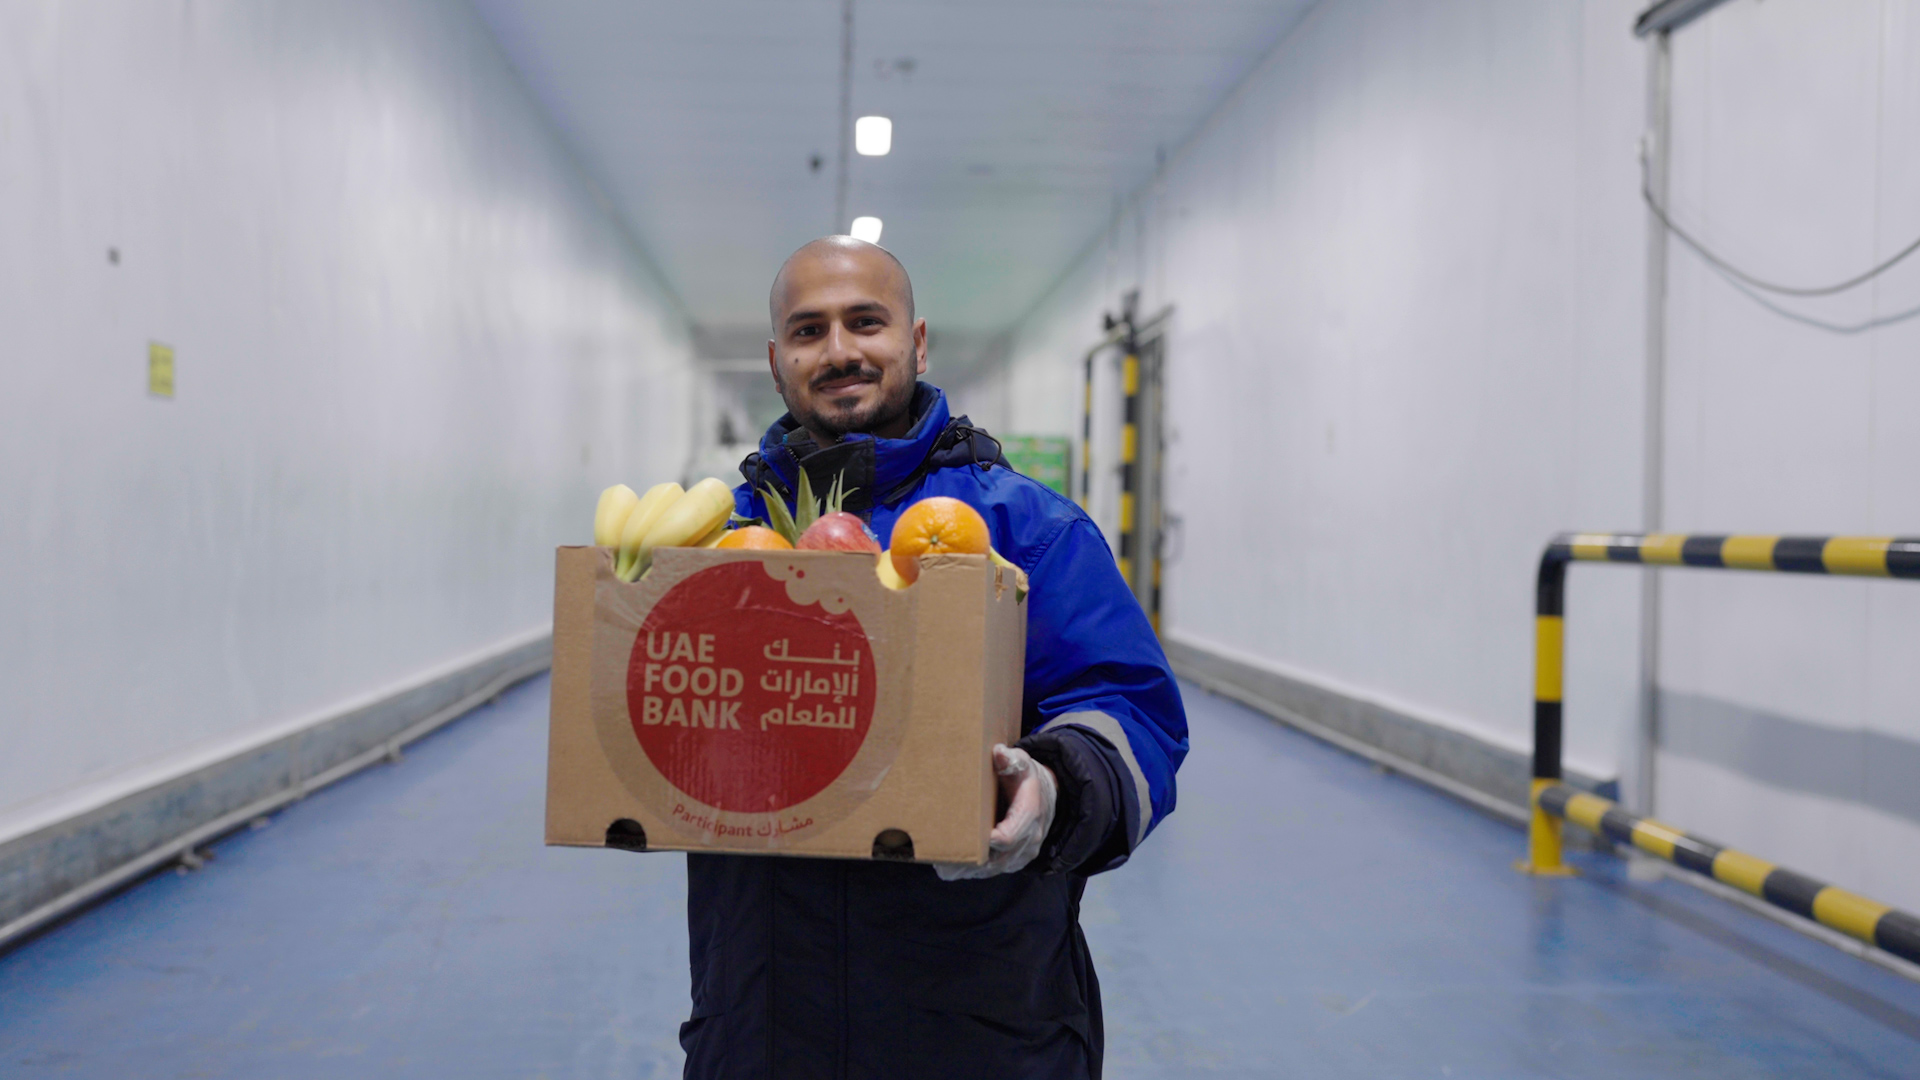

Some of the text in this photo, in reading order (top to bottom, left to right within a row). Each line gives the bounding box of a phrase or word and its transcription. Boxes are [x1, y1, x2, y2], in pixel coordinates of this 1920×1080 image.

[646, 631, 715, 663] UAE
[763, 638, 861, 672] بنك
[644, 663, 744, 697] FOOD
[760, 669, 859, 703] الإمارات
[642, 696, 743, 730] BANK
[760, 702, 856, 731] للطعام
[672, 803, 752, 837] Participant
[757, 816, 813, 838] مشارك
